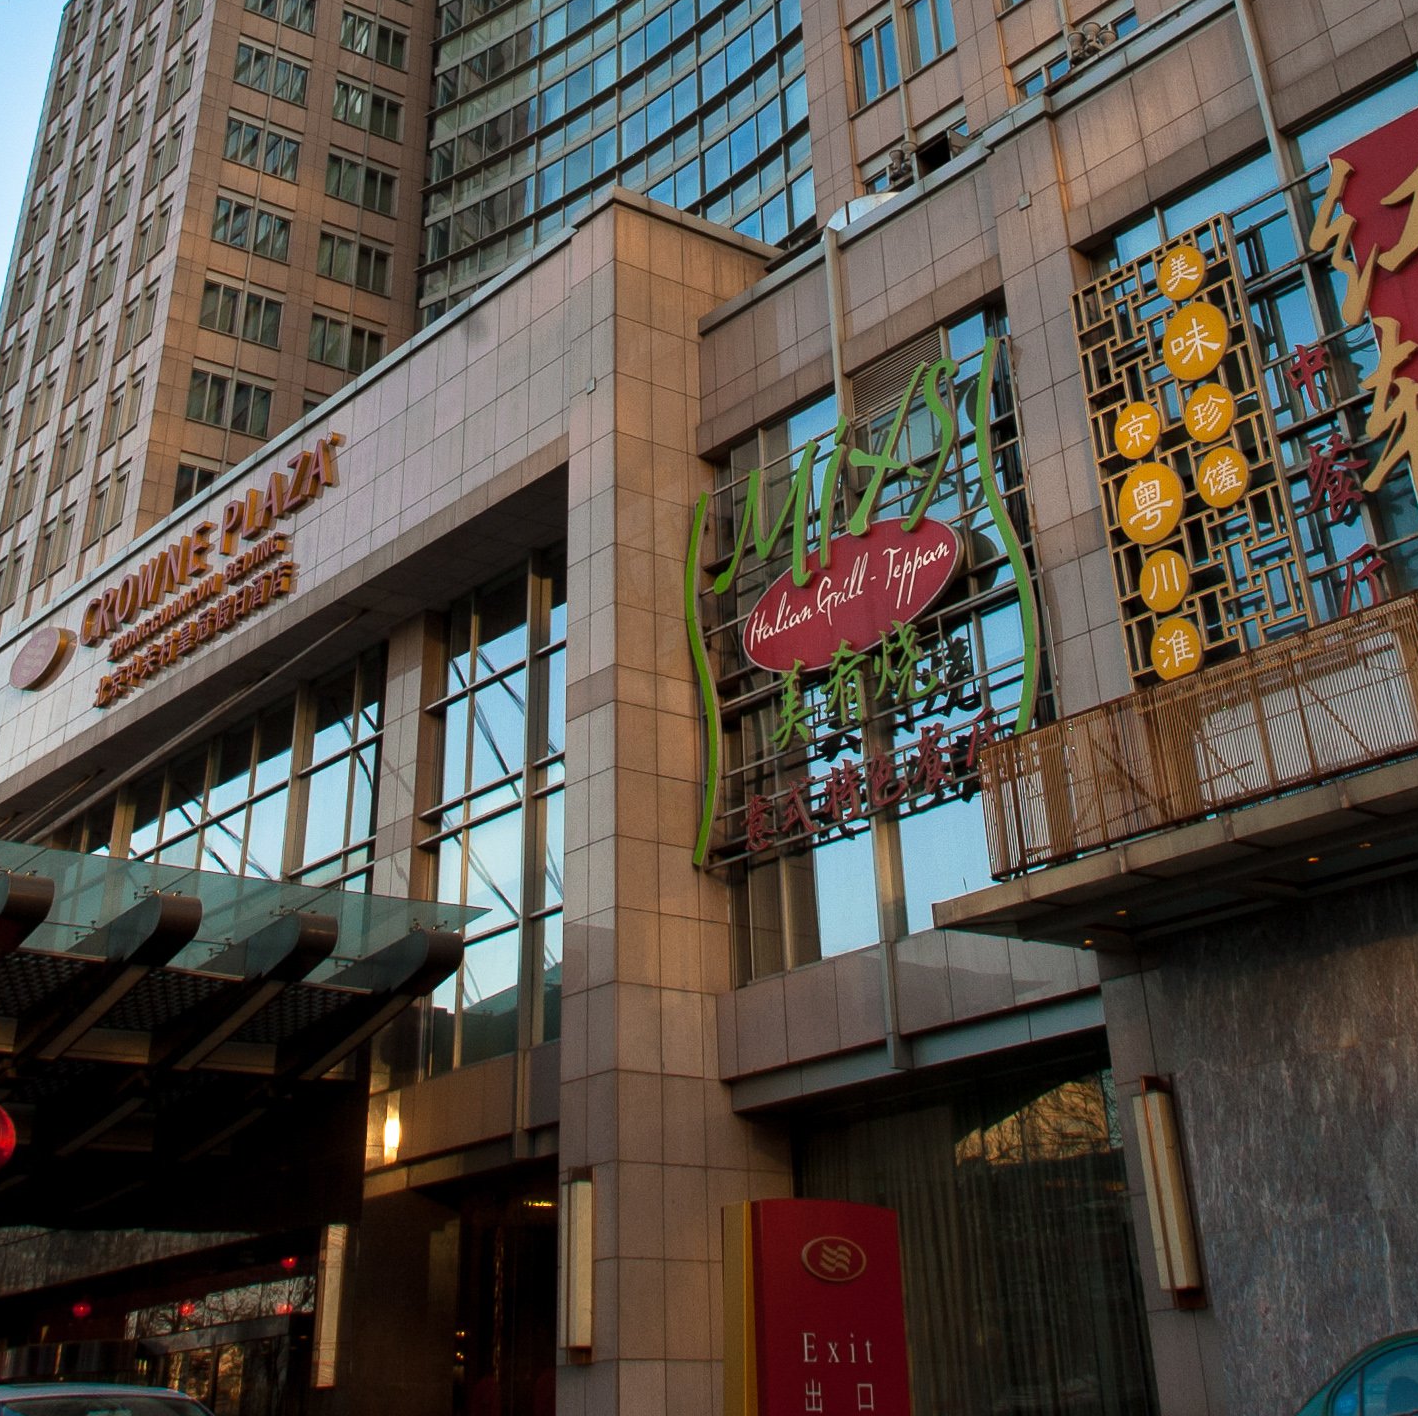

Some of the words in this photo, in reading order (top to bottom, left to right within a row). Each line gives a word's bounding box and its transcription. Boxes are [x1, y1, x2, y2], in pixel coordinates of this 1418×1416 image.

[1165, 252, 1245, 498] 美味珍馐
[81, 520, 216, 647] CROWNE
[219, 438, 339, 556] PLAZA
[1119, 412, 1194, 669] 京粤川淮
[1286, 343, 1386, 618] 中餐厅
[107, 573, 224, 662] ZHONGGUANCUN
[224, 532, 287, 584] BEIJING
[750, 591, 813, 652] Italian
[815, 552, 869, 628] Grill
[882, 540, 950, 610] Teppan
[802, 1332, 874, 1363] Exit
[804, 1378, 874, 1413] 出口
